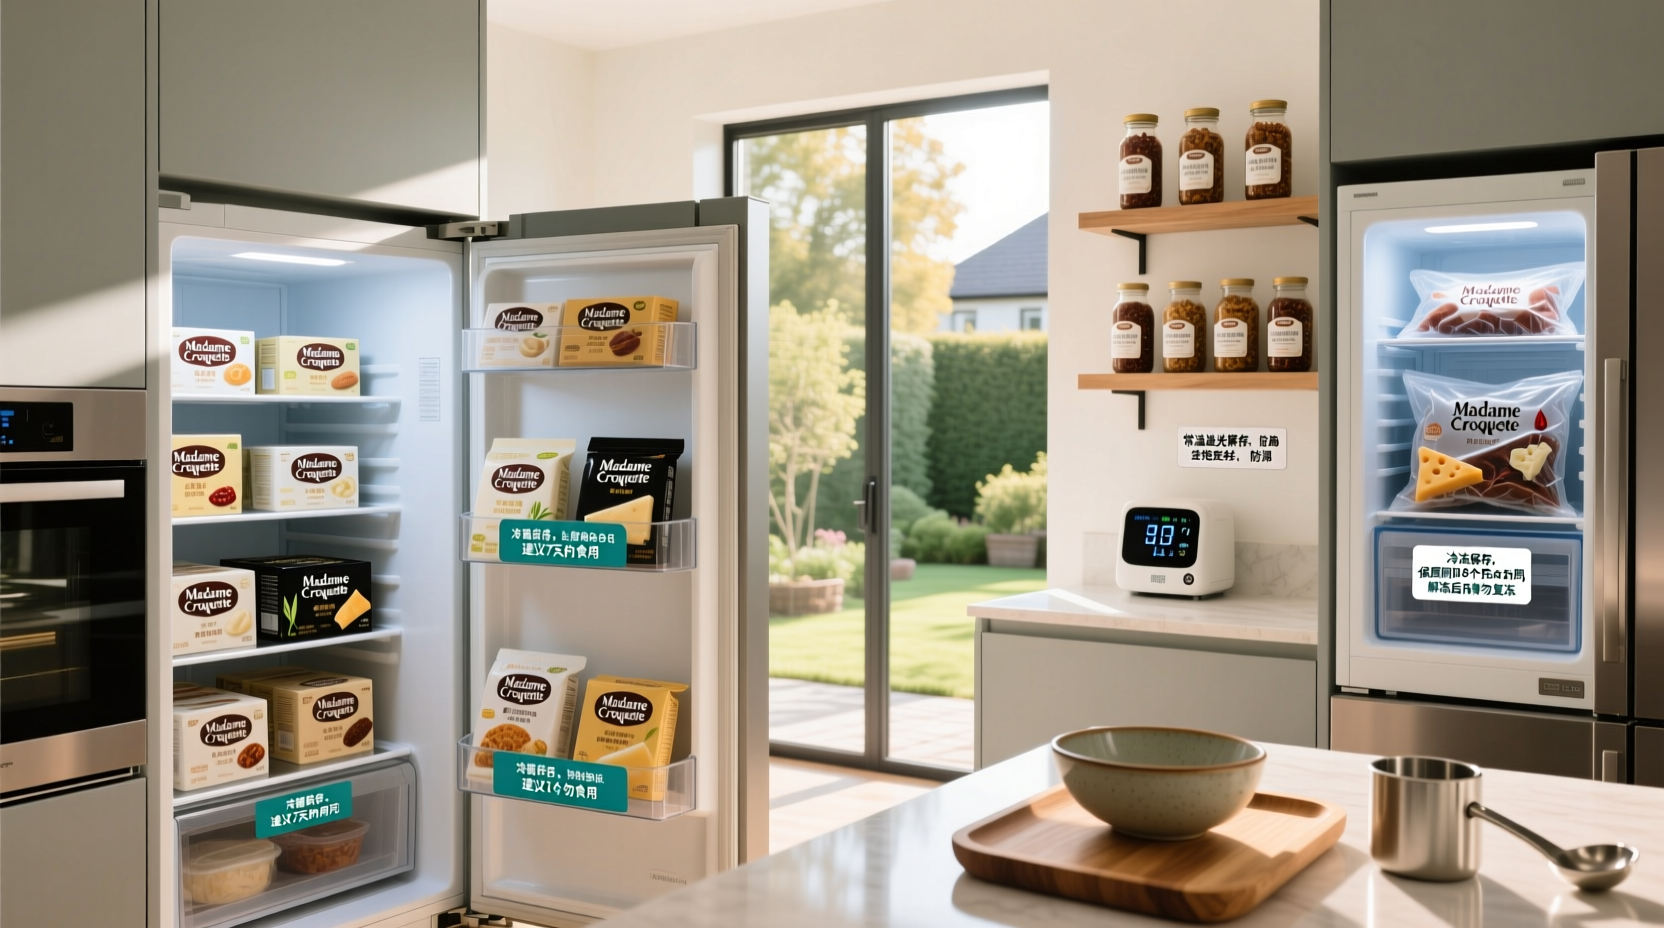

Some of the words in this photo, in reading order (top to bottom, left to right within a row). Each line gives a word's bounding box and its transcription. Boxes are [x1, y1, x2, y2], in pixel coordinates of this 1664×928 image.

[1452, 400, 1521, 418] Madame
[173, 449, 220, 462] Madame
[599, 458, 652, 472] Madame
